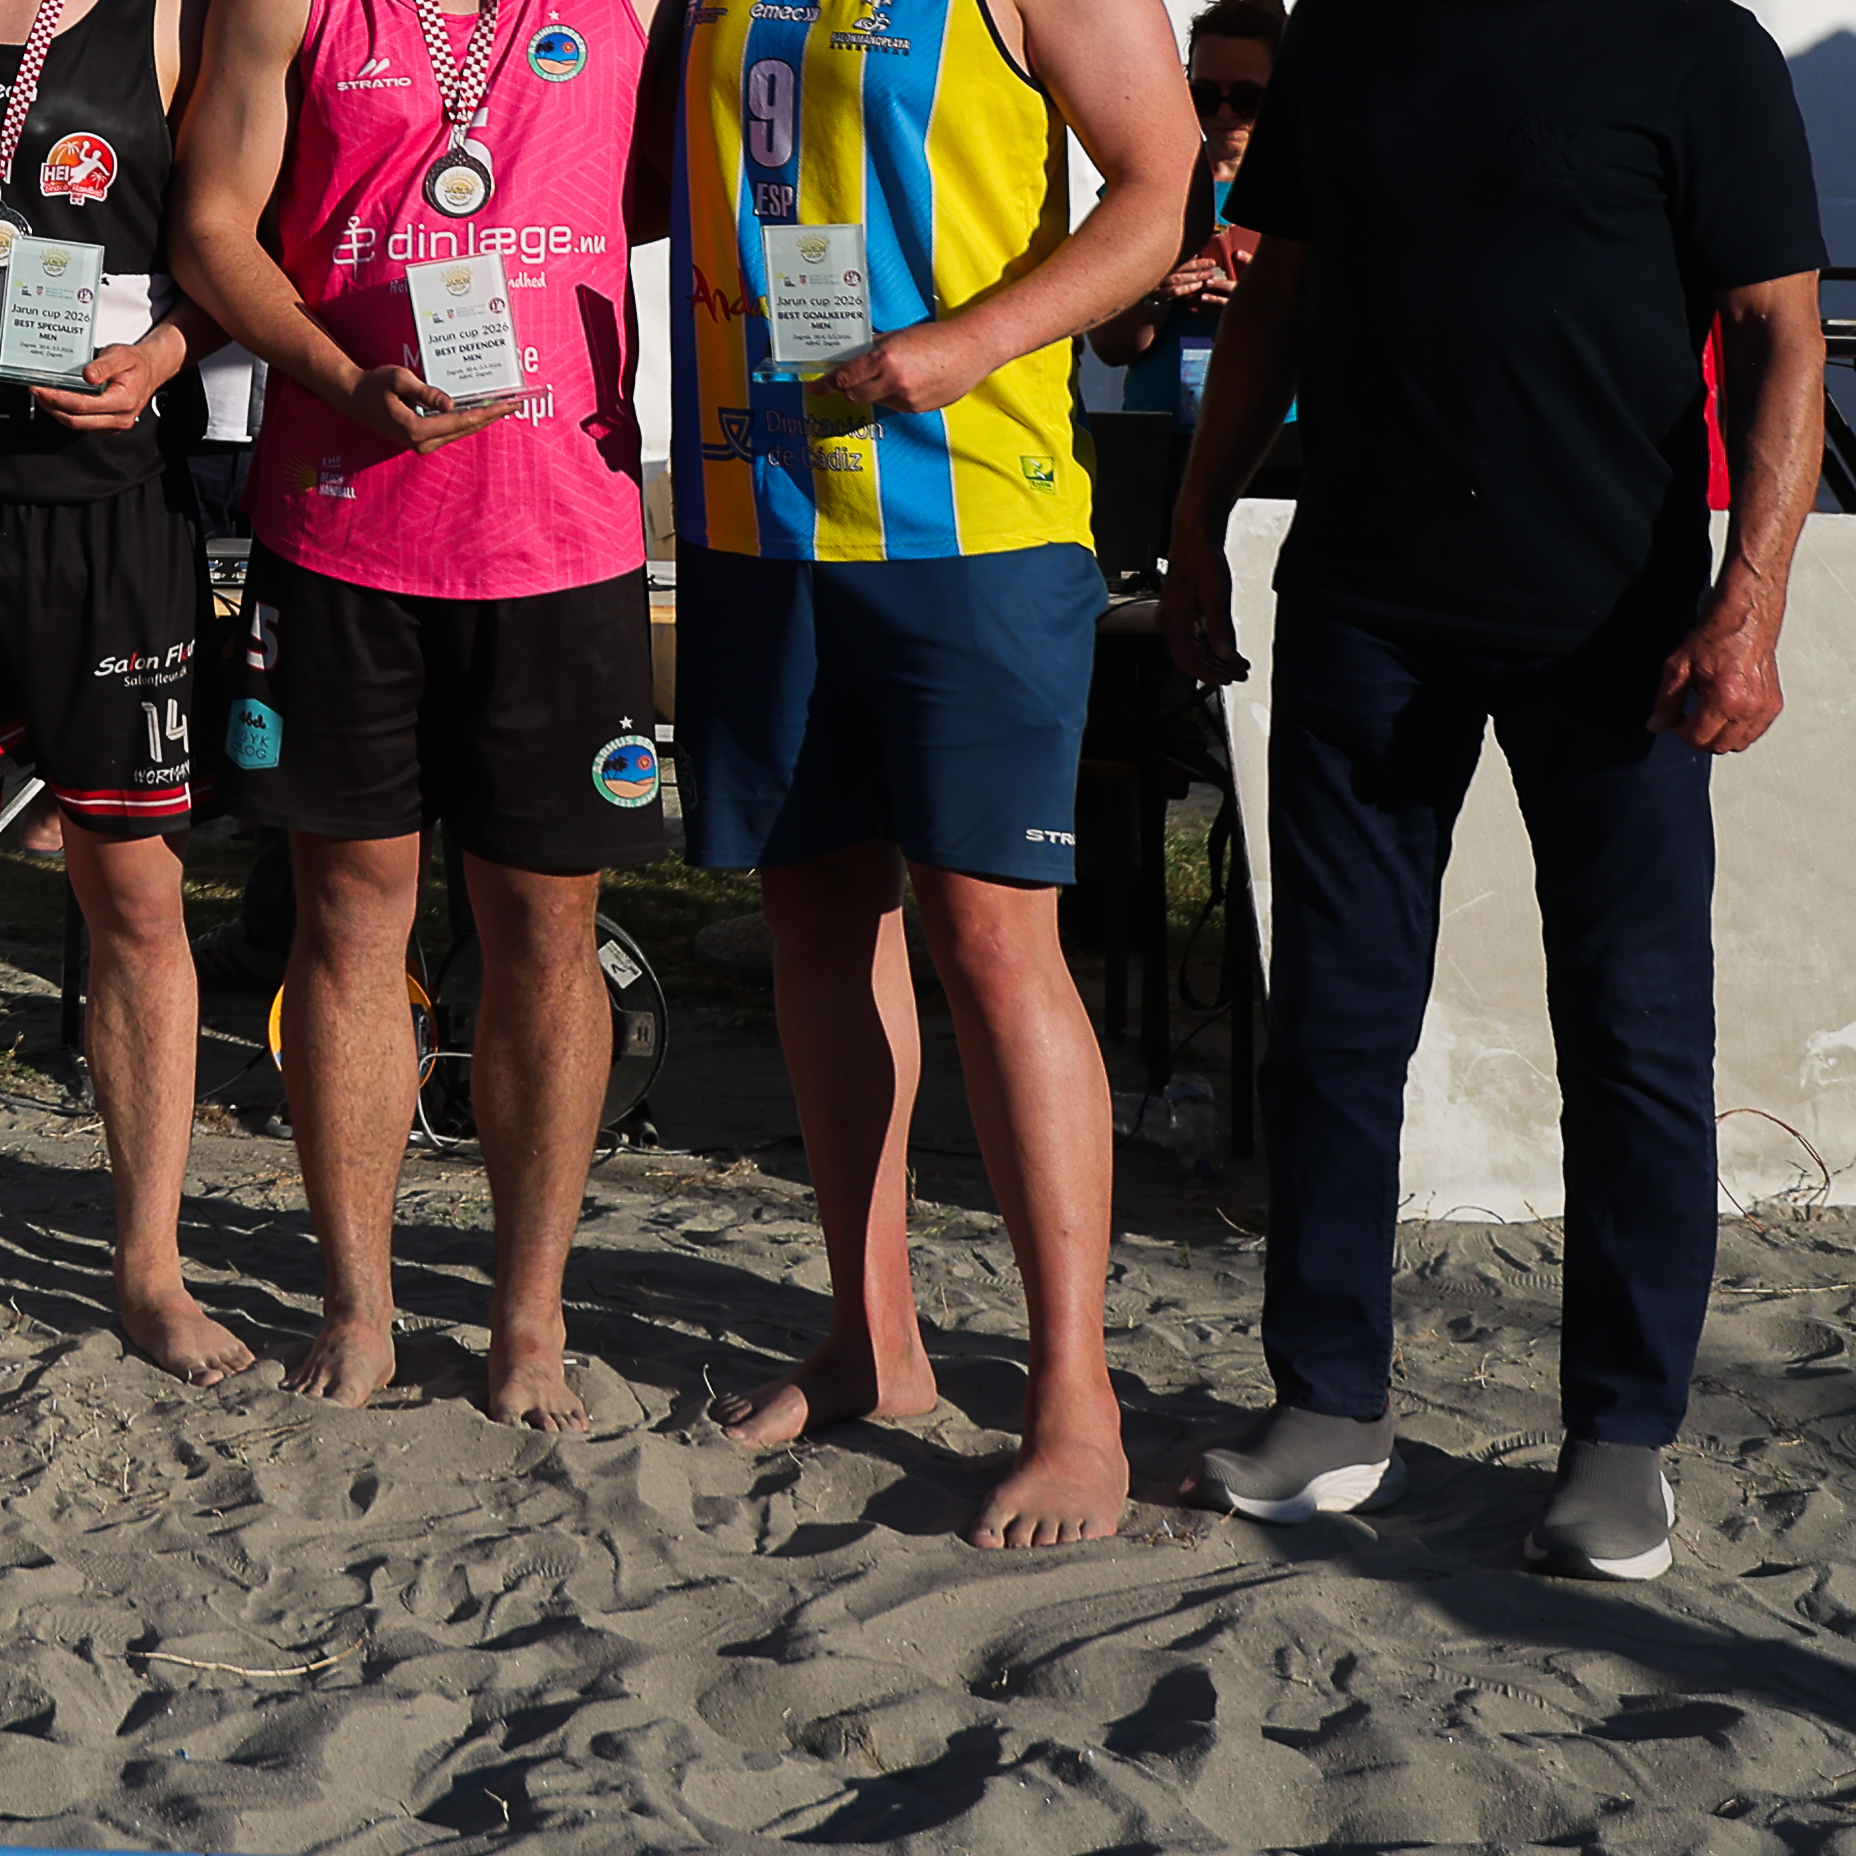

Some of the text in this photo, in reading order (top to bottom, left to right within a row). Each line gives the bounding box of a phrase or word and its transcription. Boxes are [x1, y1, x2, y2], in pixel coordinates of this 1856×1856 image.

[750, 3, 804, 20] emec
[337, 77, 412, 91] STRATIO
[748, 58, 795, 167] 9
[44, 166, 70, 182] HEI
[754, 183, 794, 217] ESP
[777, 296, 863, 308] Jarun cup 2026
[11, 304, 90, 322] Jarun cup 2026
[778, 311, 864, 319] BEST GOALKEEPER
[14, 319, 84, 334] BEST SPECIALIST
[427, 323, 509, 344] Jarun cup 2026
[39, 333, 57, 341] MEN
[435, 338, 506, 357] BEST DEFENDER
[463, 353, 482, 362] MEN
[766, 409, 886, 440] Diputación
[768, 445, 863, 472] de Cádiz
[245, 601, 281, 672] 5
[94, 652, 159, 677] Salon
[141, 699, 189, 763] 14
